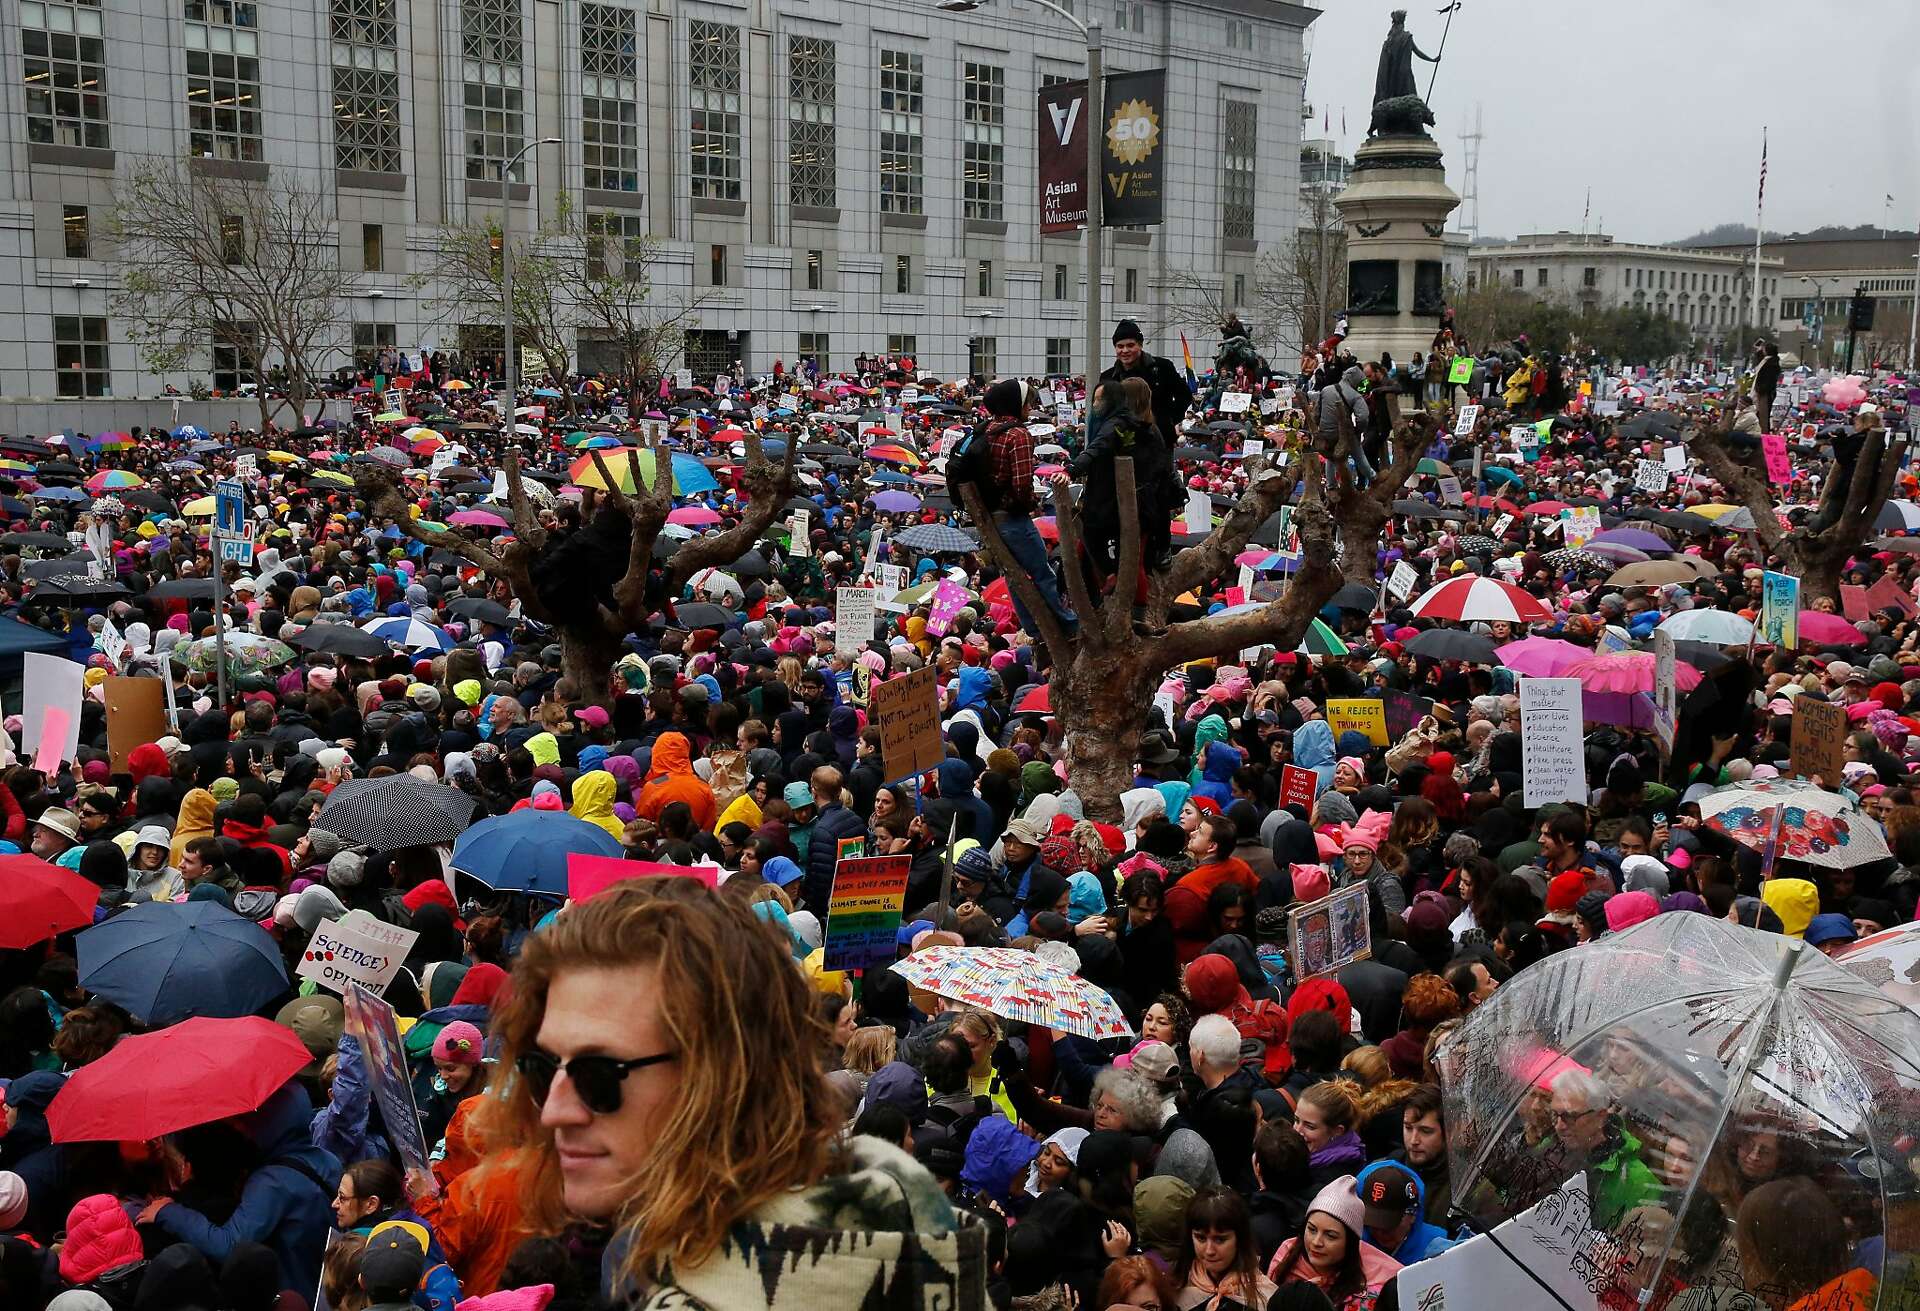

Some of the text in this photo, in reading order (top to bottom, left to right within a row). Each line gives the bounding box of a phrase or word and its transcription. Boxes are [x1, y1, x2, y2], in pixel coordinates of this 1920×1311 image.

[1115, 117, 1152, 141] 50
[1132, 171, 1153, 180] Asian
[1045, 180, 1078, 196] Asian
[1045, 196, 1062, 209] Art
[1045, 208, 1089, 224] Museum
[1463, 407, 1476, 416] YES
[1461, 416, 1472, 424] WE
[1457, 425, 1471, 433] CAN
[1643, 460, 1664, 469] MAKE
[1641, 467, 1668, 477] RACISTS
[1640, 474, 1663, 483] AFRAID
[1640, 480, 1662, 490] AGAIN
[217, 484, 243, 500] PAY HERE
[846, 589, 868, 599] MARCH
[1777, 588, 1789, 597] THE
[850, 612, 872, 621] PLANET
[1526, 685, 1566, 699] Things that
[1328, 706, 1380, 716] WE REJECT
[880, 711, 896, 731] NOT
[1531, 712, 1569, 721] Black Lives
[1336, 720, 1372, 730] TRUMP'S
[1532, 723, 1567, 732] Education
[1532, 734, 1561, 742] Science
[1533, 745, 1573, 755] Healthcare
[1533, 766, 1576, 775] Clean water
[1534, 775, 1568, 788] Diversity
[1286, 789, 1310, 801] Abortion
[1534, 787, 1566, 798] Freedom
[839, 861, 872, 876] LOVE
[876, 861, 886, 873] IS
[834, 879, 904, 891] BLACK LIVES MATTER
[830, 900, 857, 909] CLIMATE
[860, 898, 880, 906] CHANGE
[1372, 1181, 1386, 1202] SF
